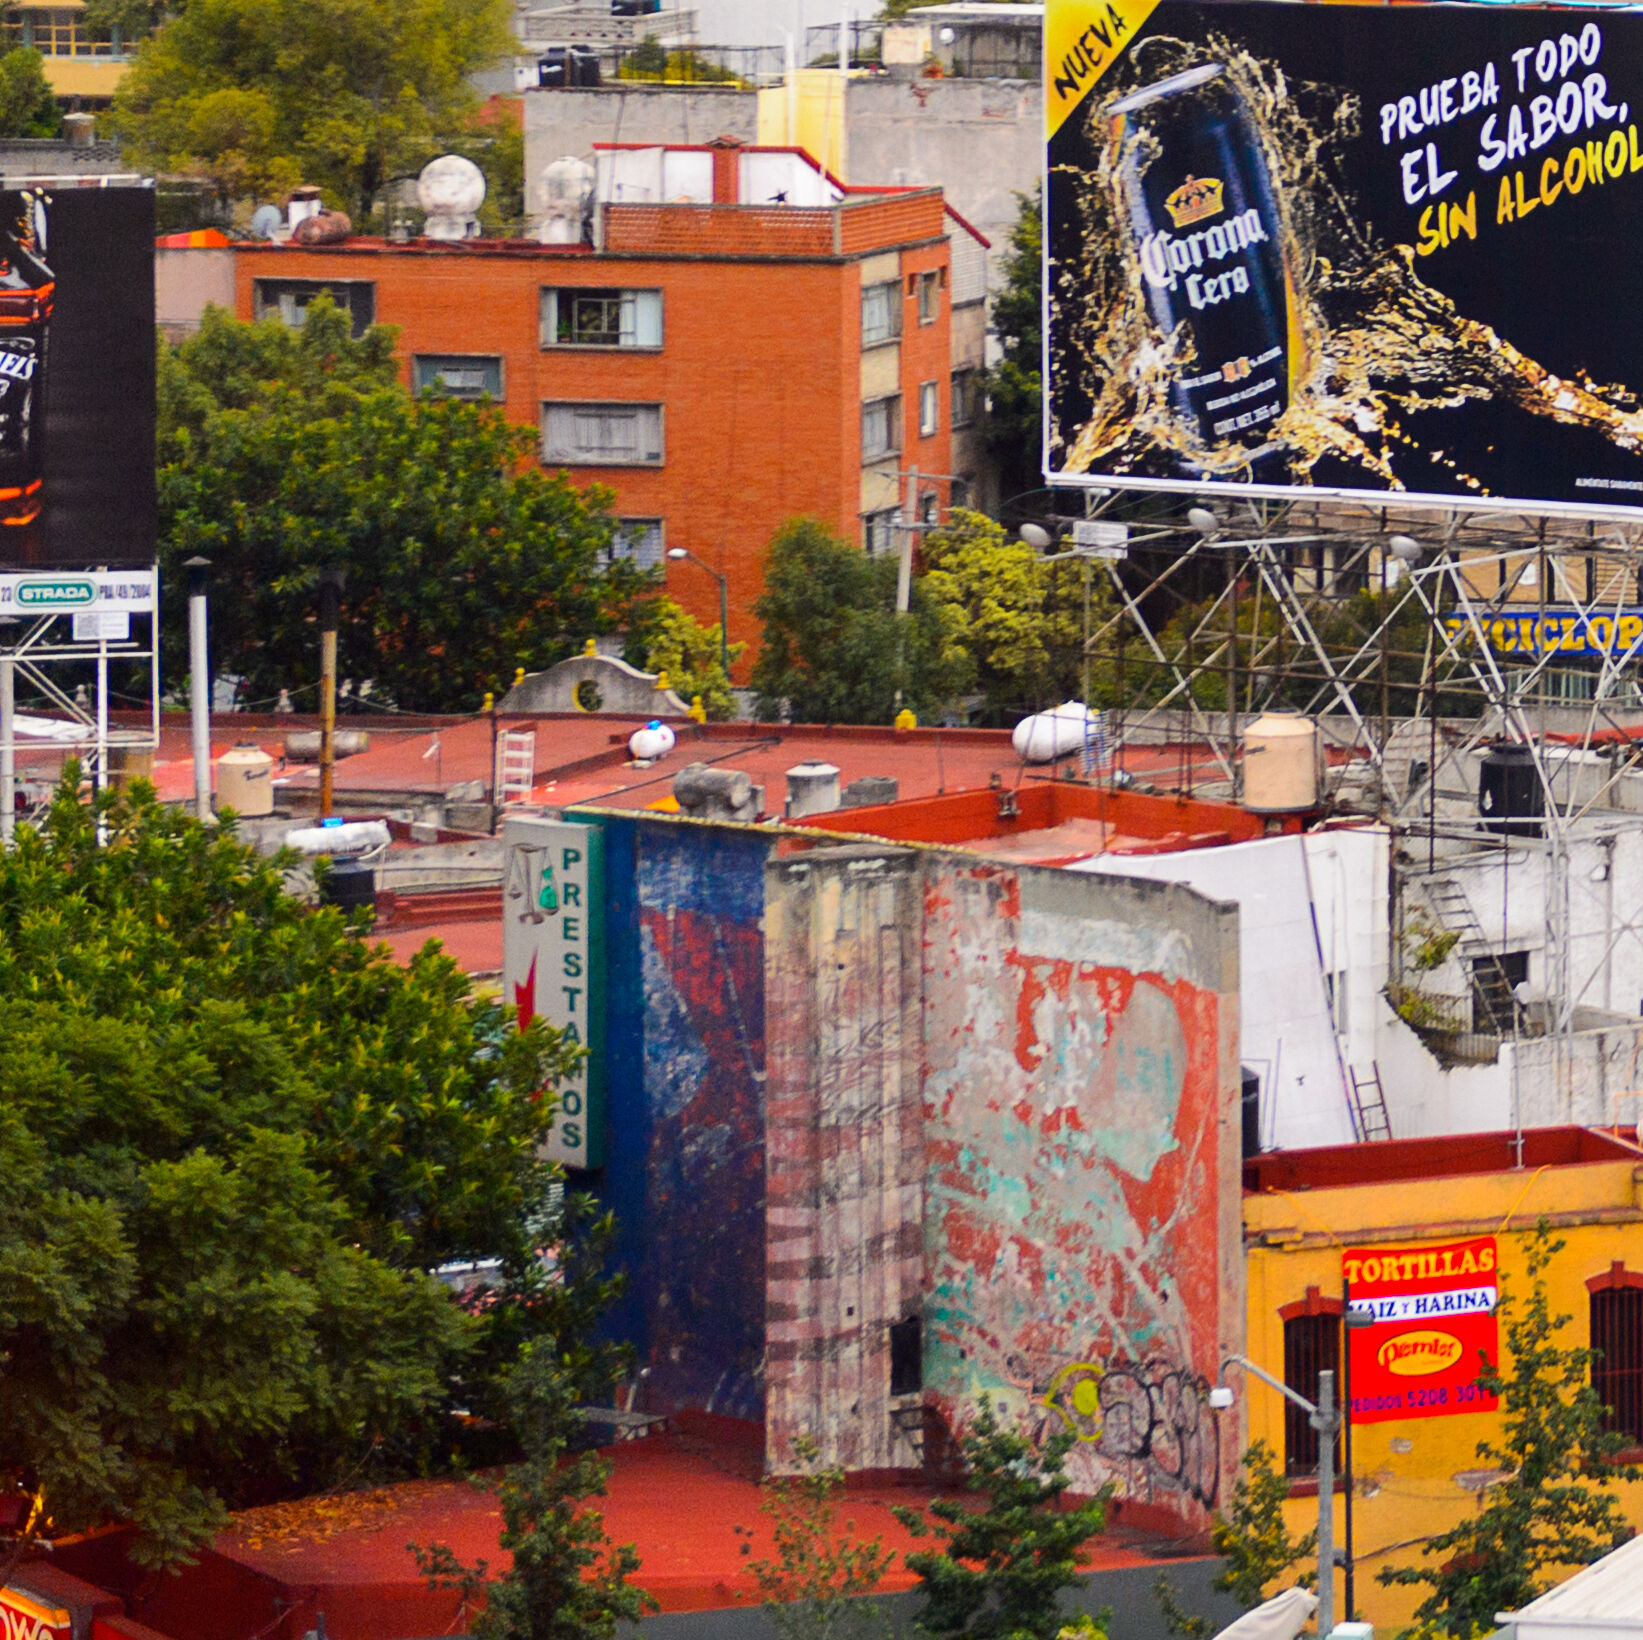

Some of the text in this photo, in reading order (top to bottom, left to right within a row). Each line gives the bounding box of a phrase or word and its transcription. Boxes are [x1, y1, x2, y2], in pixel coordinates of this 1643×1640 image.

[1054, 3, 1128, 100] NUEVA
[1380, 23, 1601, 145] PRUEBA TODO
[1400, 73, 1628, 205] EL SABOR,
[1140, 208, 1270, 291] Corona
[1416, 191, 1477, 256] SIN
[1185, 266, 1250, 310] Cero
[21, 586, 90, 601] STRADA
[562, 848, 583, 1148] PRESTAOS
[1344, 1248, 1494, 1284] TORTILLAS
[1415, 1291, 1490, 1314] HARINA
[1407, 1387, 1448, 1408] 5208
